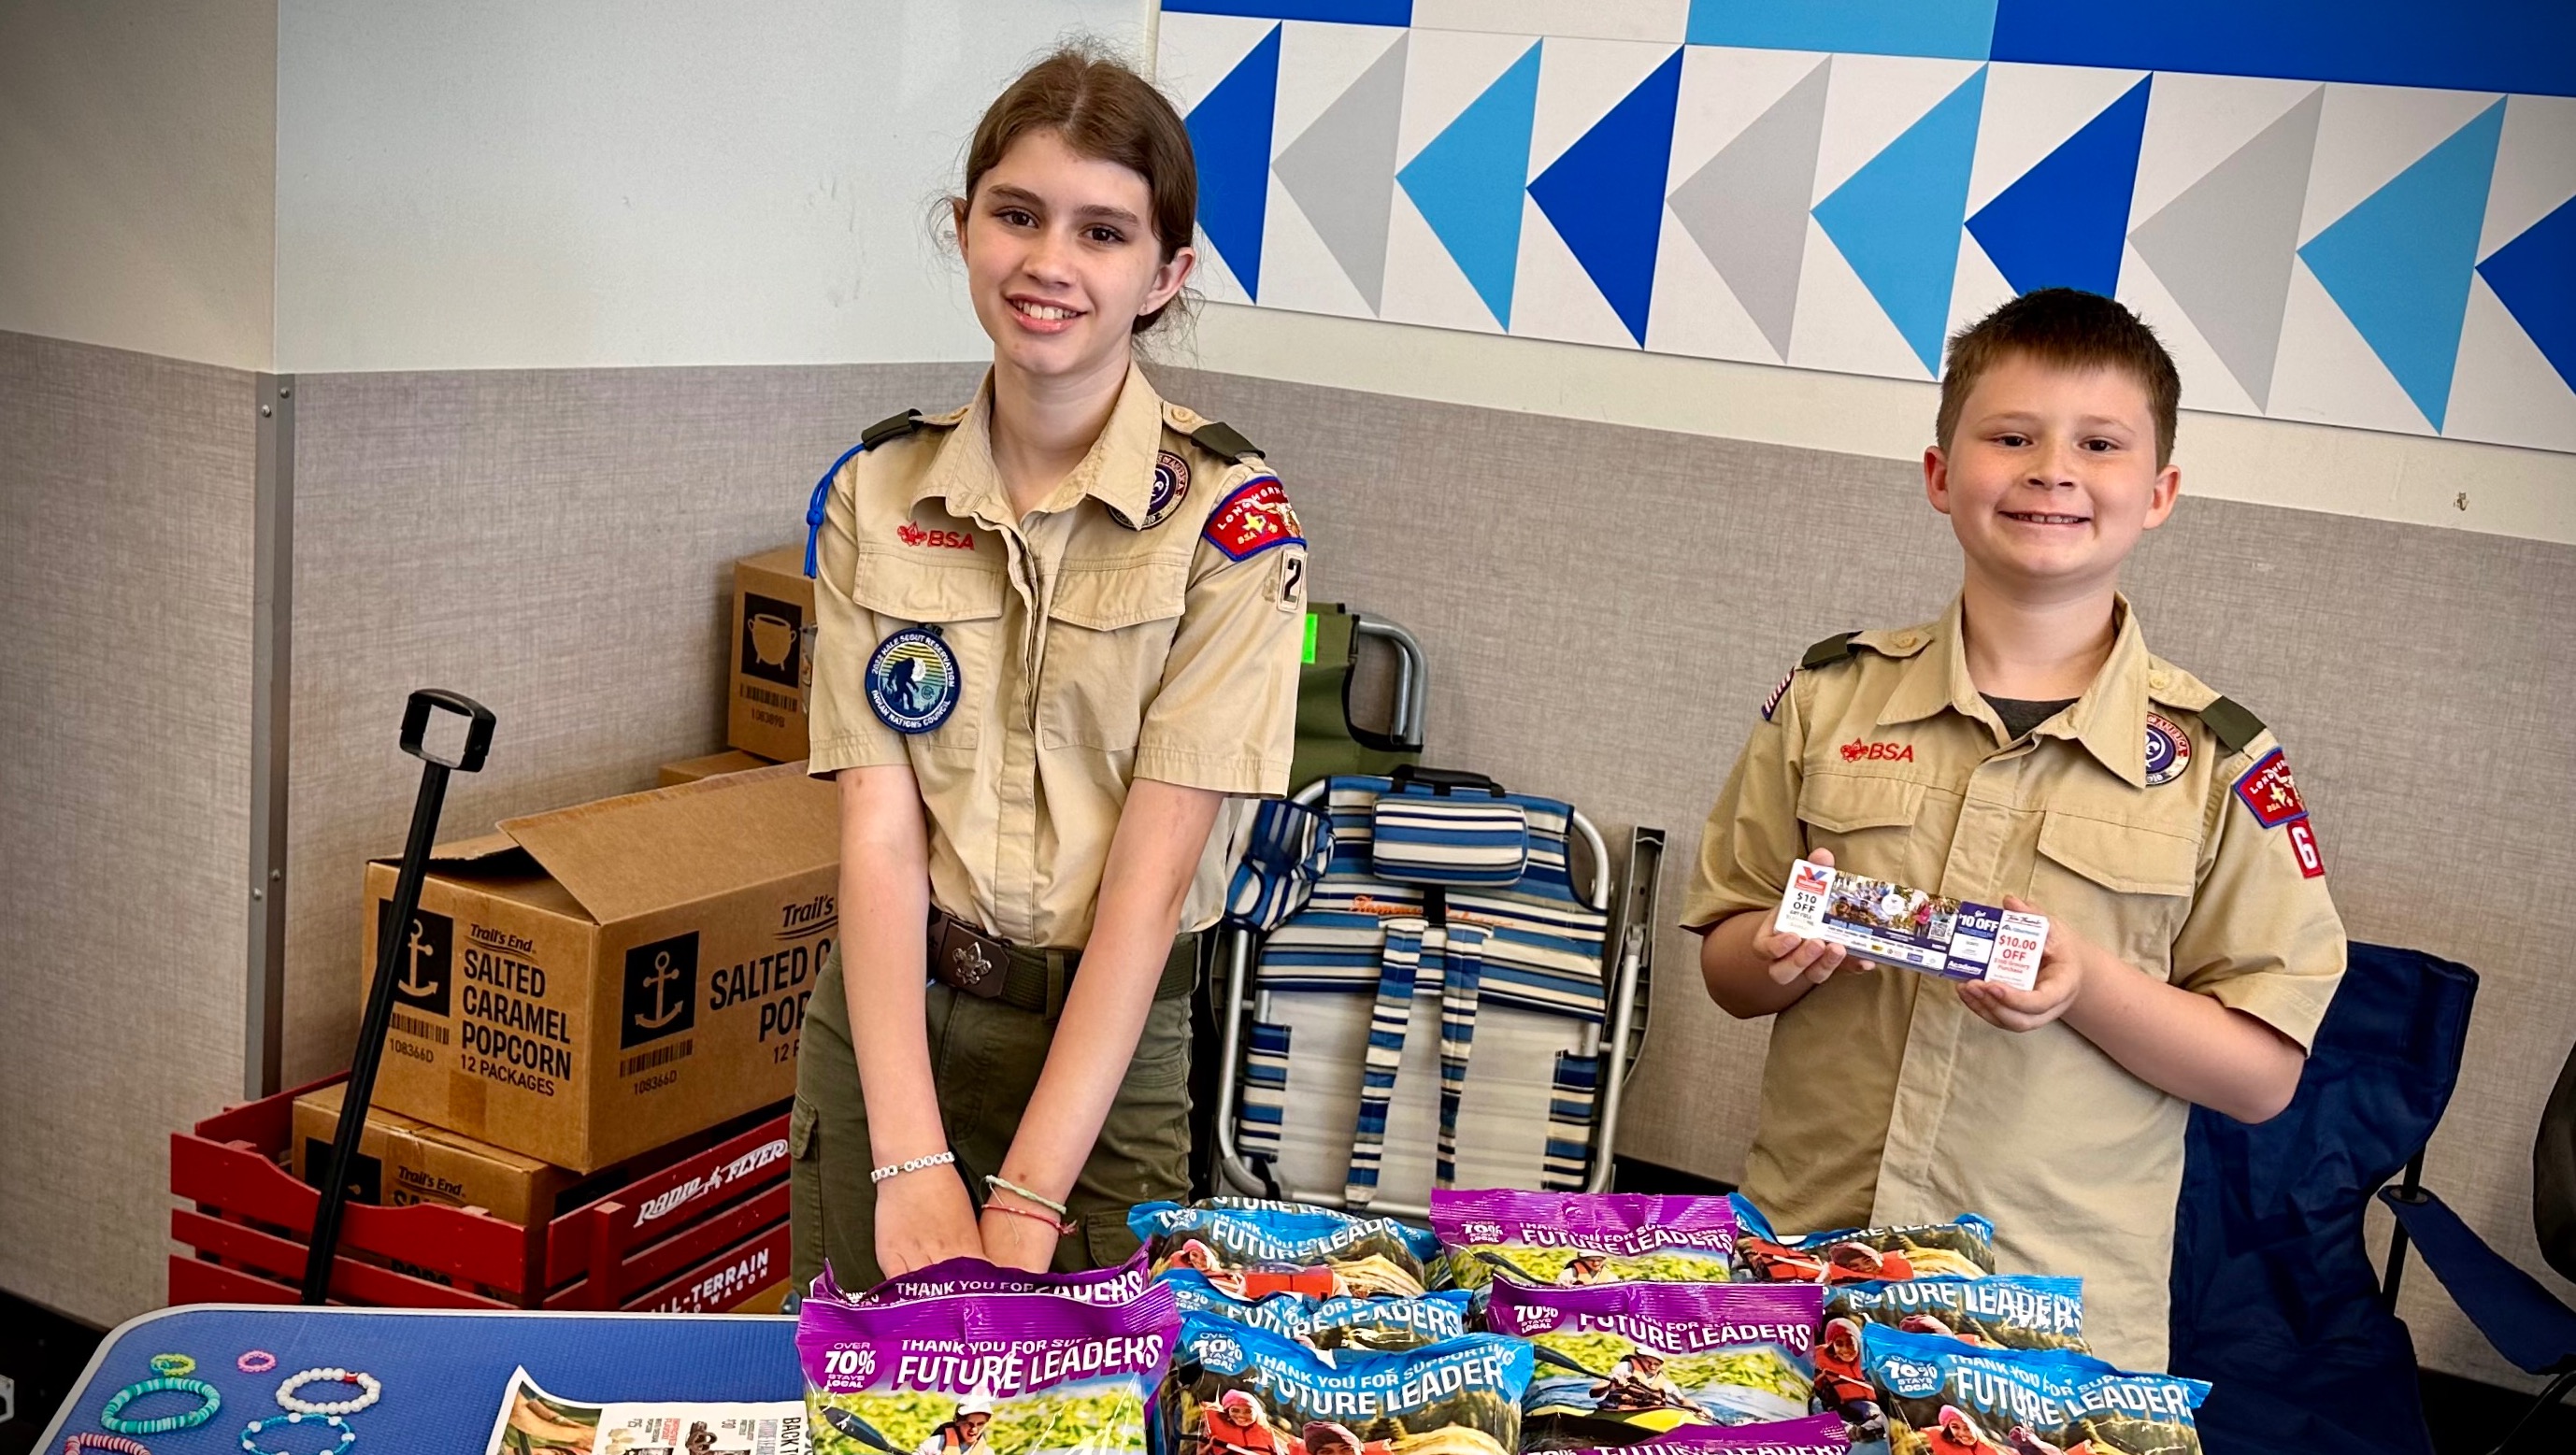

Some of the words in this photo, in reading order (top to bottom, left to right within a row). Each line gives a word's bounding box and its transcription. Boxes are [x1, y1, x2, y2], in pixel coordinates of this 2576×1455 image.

[927, 530, 975, 550] BSA
[1283, 558, 1302, 602] 2
[881, 637, 899, 656] HALE
[900, 634, 925, 643] SCOUT
[925, 637, 955, 688] RESERVATION
[870, 689, 889, 717] INDIAN
[888, 715, 922, 728] NATIONS
[923, 700, 952, 726] COUNCIL
[1868, 743, 1914, 763] BSA
[2291, 826, 2318, 869] 6
[782, 894, 835, 928] Trail's
[1793, 902, 1815, 913] OFF
[1796, 892, 1817, 904] $10
[470, 923, 506, 945] Trail's
[508, 935, 533, 952] End
[1975, 918, 1999, 932] OFF
[1998, 935, 2037, 950] $10.00
[2002, 949, 2026, 961] OFF
[464, 949, 546, 998] SALTED
[709, 946, 809, 1011] SALTED
[463, 985, 571, 1045] CARAMEL
[390, 1038, 434, 1063] 108366D
[462, 1020, 571, 1081] POPCORN
[774, 1044, 788, 1064] 12
[461, 1054, 476, 1073] 12
[479, 1060, 555, 1097] PACKAGES
[398, 1165, 435, 1188] Trail's
[436, 1177, 463, 1195] End
[634, 1177, 702, 1228] RADIO
[722, 1139, 789, 1183] FLYER
[1212, 1219, 1312, 1260] FUTURE
[1523, 1229, 1622, 1256] FUTURE
[1625, 1230, 1733, 1255] LEADERS
[651, 1248, 769, 1313] LL-TERRAIN
[710, 1266, 767, 1305] WAGON
[895, 1280, 955, 1297] THANK
[959, 1280, 995, 1291] YOU
[1176, 1291, 1209, 1305] 0%
[1521, 1323, 1552, 1334] LOCAL
[1580, 1313, 1682, 1351] FUTURE
[1688, 1324, 1810, 1352] LEADERS
[1666, 1321, 1699, 1332] FOR
[834, 1342, 871, 1350] OVER
[901, 1339, 965, 1355] THANK
[968, 1340, 1006, 1355] YOU
[1011, 1338, 1048, 1355] FOR
[1189, 1338, 1243, 1362] 70%
[824, 1349, 877, 1376] 70%
[896, 1355, 1023, 1391] FUTURE
[1029, 1334, 1164, 1386] LEADERS
[1253, 1351, 1312, 1385] THANK
[1317, 1375, 1355, 1390] YOU
[1361, 1373, 1399, 1390] FOR
[1403, 1343, 1516, 1381] SUPPORTING
[1885, 1361, 1938, 1379] 70%
[1948, 1355, 2009, 1374] THANK
[2011, 1365, 2039, 1387] YOU
[2043, 1380, 2074, 1396] FOR
[826, 1379, 864, 1389] LOCAL
[1256, 1365, 1377, 1415] FUTURE
[1386, 1355, 1505, 1412] LEADER
[1898, 1384, 1936, 1392] LOCAL
[1957, 1367, 2064, 1425] FUTURE
[780, 1417, 802, 1446] BACK
